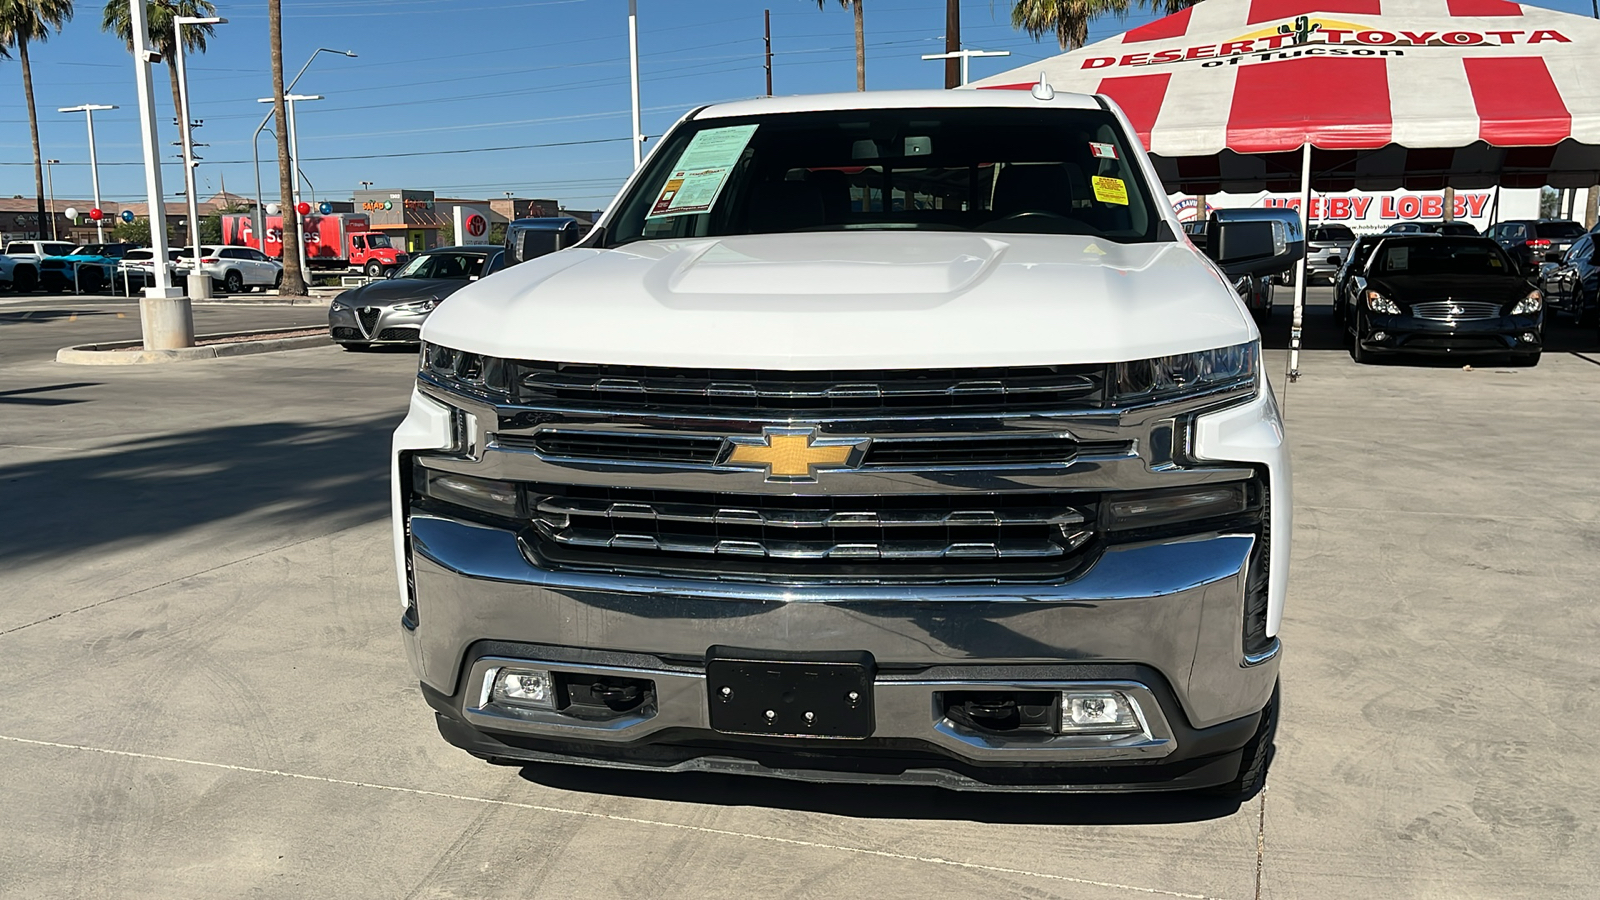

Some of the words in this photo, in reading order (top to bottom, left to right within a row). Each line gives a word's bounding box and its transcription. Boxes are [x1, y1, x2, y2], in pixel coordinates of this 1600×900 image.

[1080, 33, 1295, 70] DESERT
[1315, 29, 1573, 45] TOYOTA
[1201, 57, 1244, 68] of
[1251, 48, 1405, 62] Tucson
[1380, 194, 1491, 220] LOBBY
[266, 228, 320, 244] Stes
